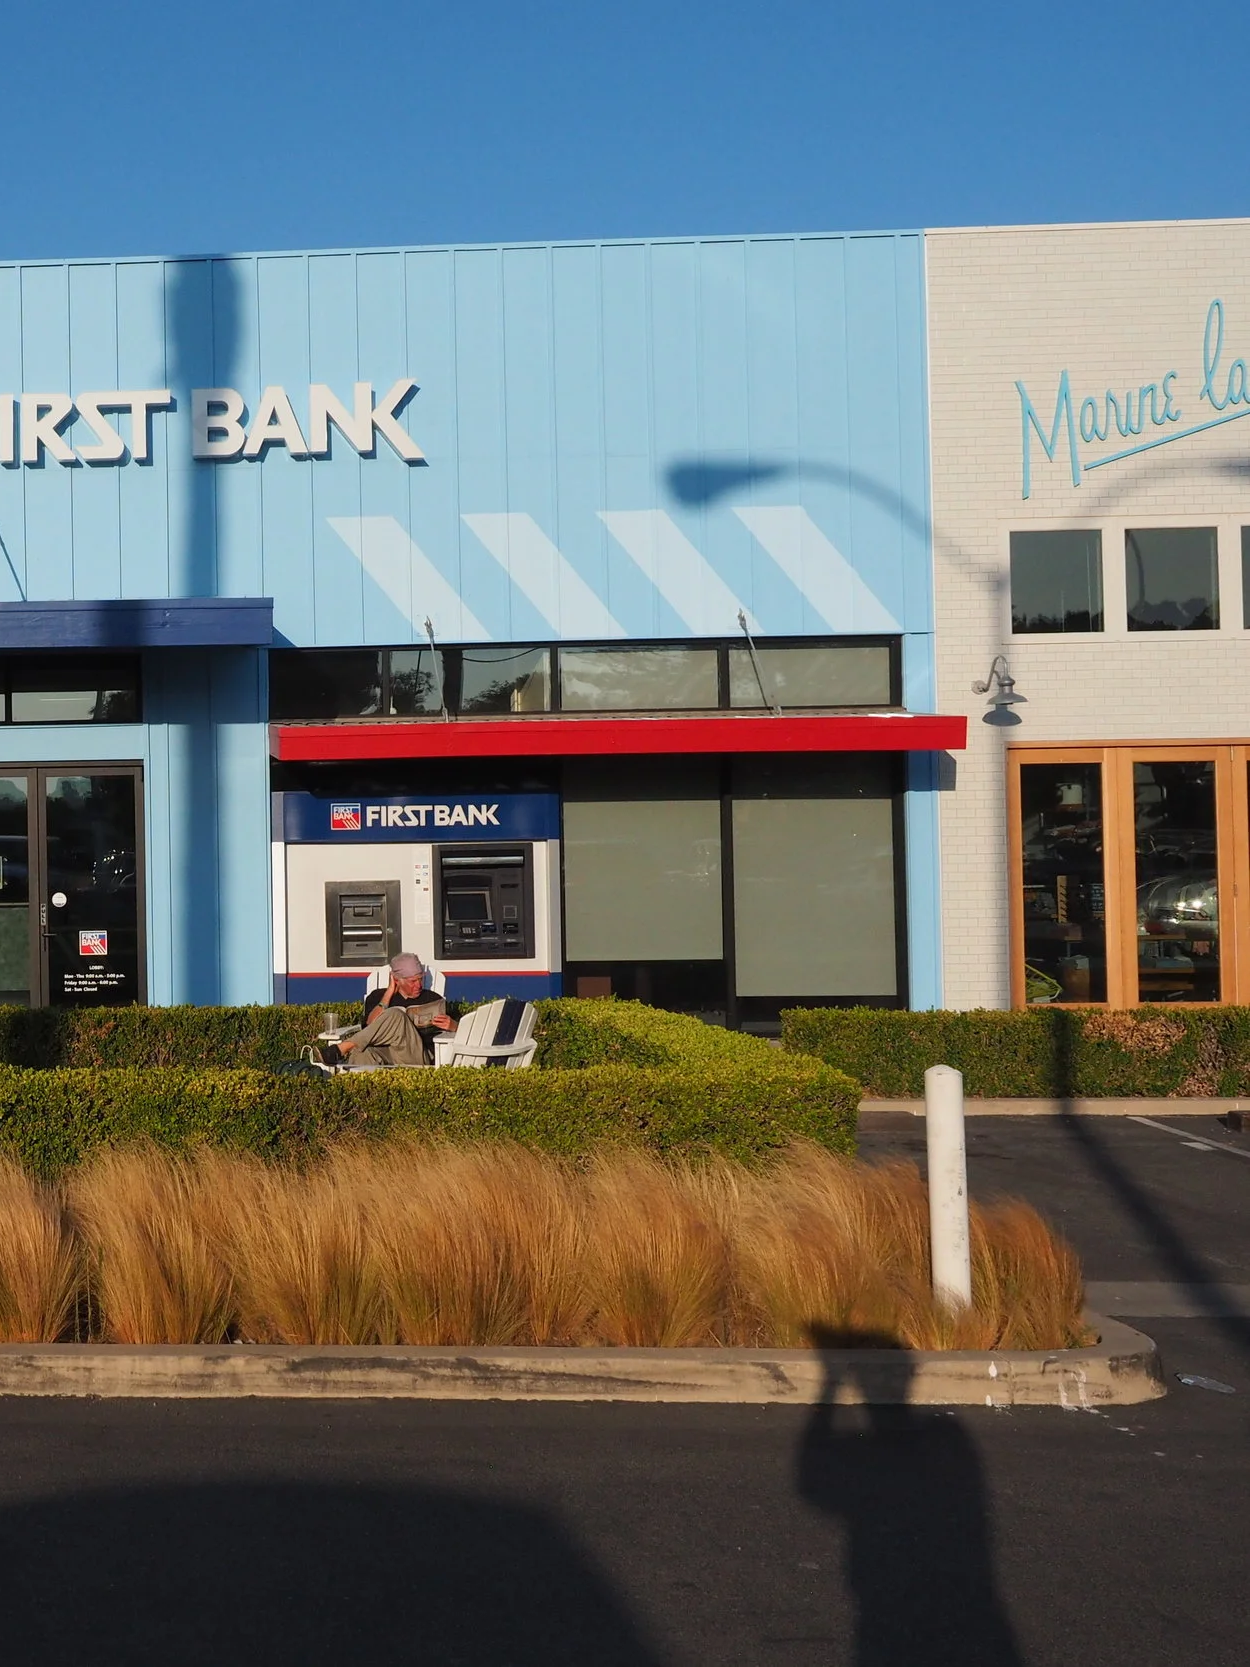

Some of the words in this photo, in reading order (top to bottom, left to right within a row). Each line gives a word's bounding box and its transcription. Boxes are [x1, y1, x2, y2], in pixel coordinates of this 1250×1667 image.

[190, 378, 426, 462] BANK
[1014, 369, 1182, 500] Marine
[334, 806, 359, 814] FIRST
[334, 813, 355, 821] BANK
